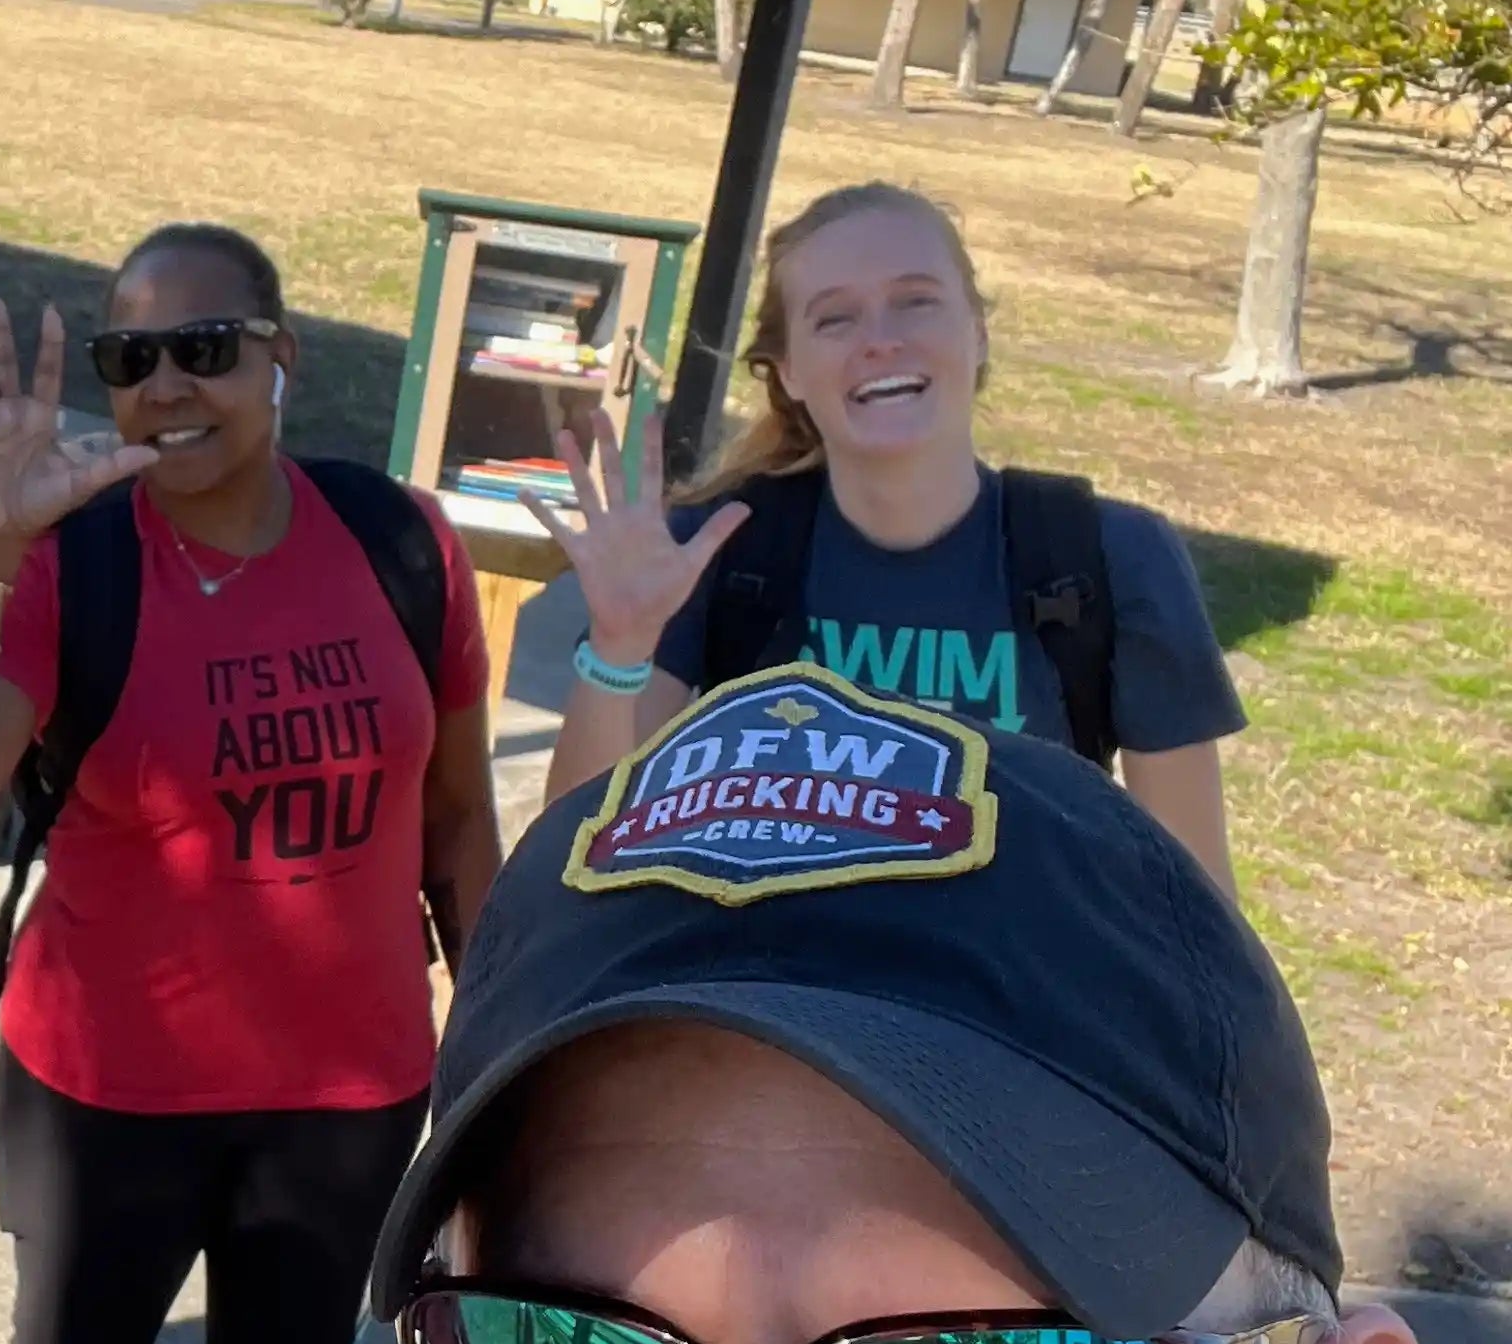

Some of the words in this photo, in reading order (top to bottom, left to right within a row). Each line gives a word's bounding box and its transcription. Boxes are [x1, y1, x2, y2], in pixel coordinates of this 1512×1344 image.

[205, 654, 279, 706] IT'S
[289, 637, 368, 694] NOT
[797, 615, 1028, 733] WIM
[212, 695, 382, 777] ABOUT
[665, 728, 905, 791] DFW
[212, 768, 385, 861] YOU
[644, 776, 900, 831] RUCKING
[702, 819, 816, 845] CREW
